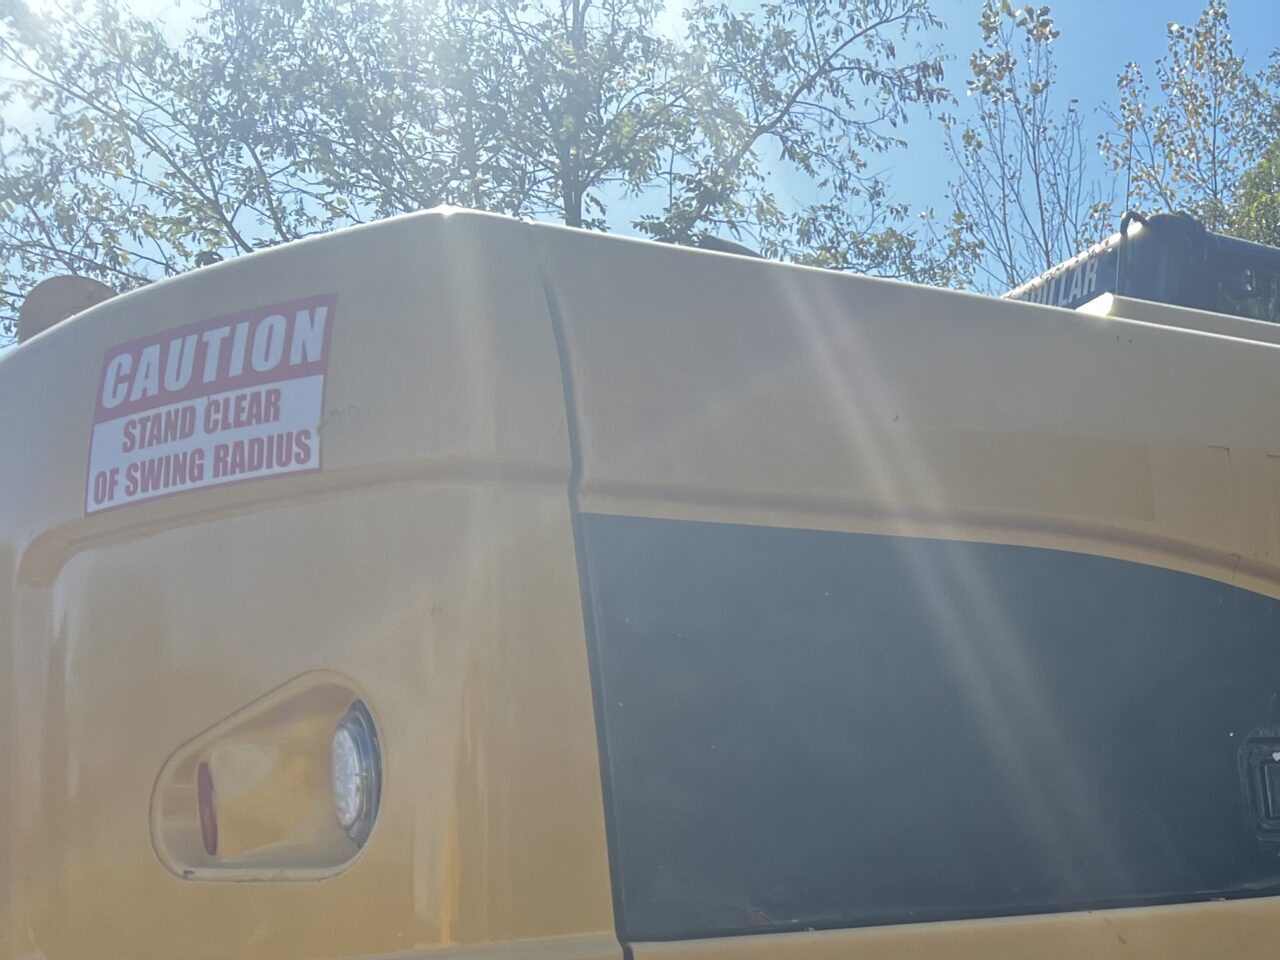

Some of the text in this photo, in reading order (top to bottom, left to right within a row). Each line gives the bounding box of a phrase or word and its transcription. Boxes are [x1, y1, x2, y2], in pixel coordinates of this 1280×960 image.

[101, 306, 328, 409] CAUTION
[122, 388, 281, 453] STAND CLEAR
[93, 429, 311, 505] OF SWING RADIUS
